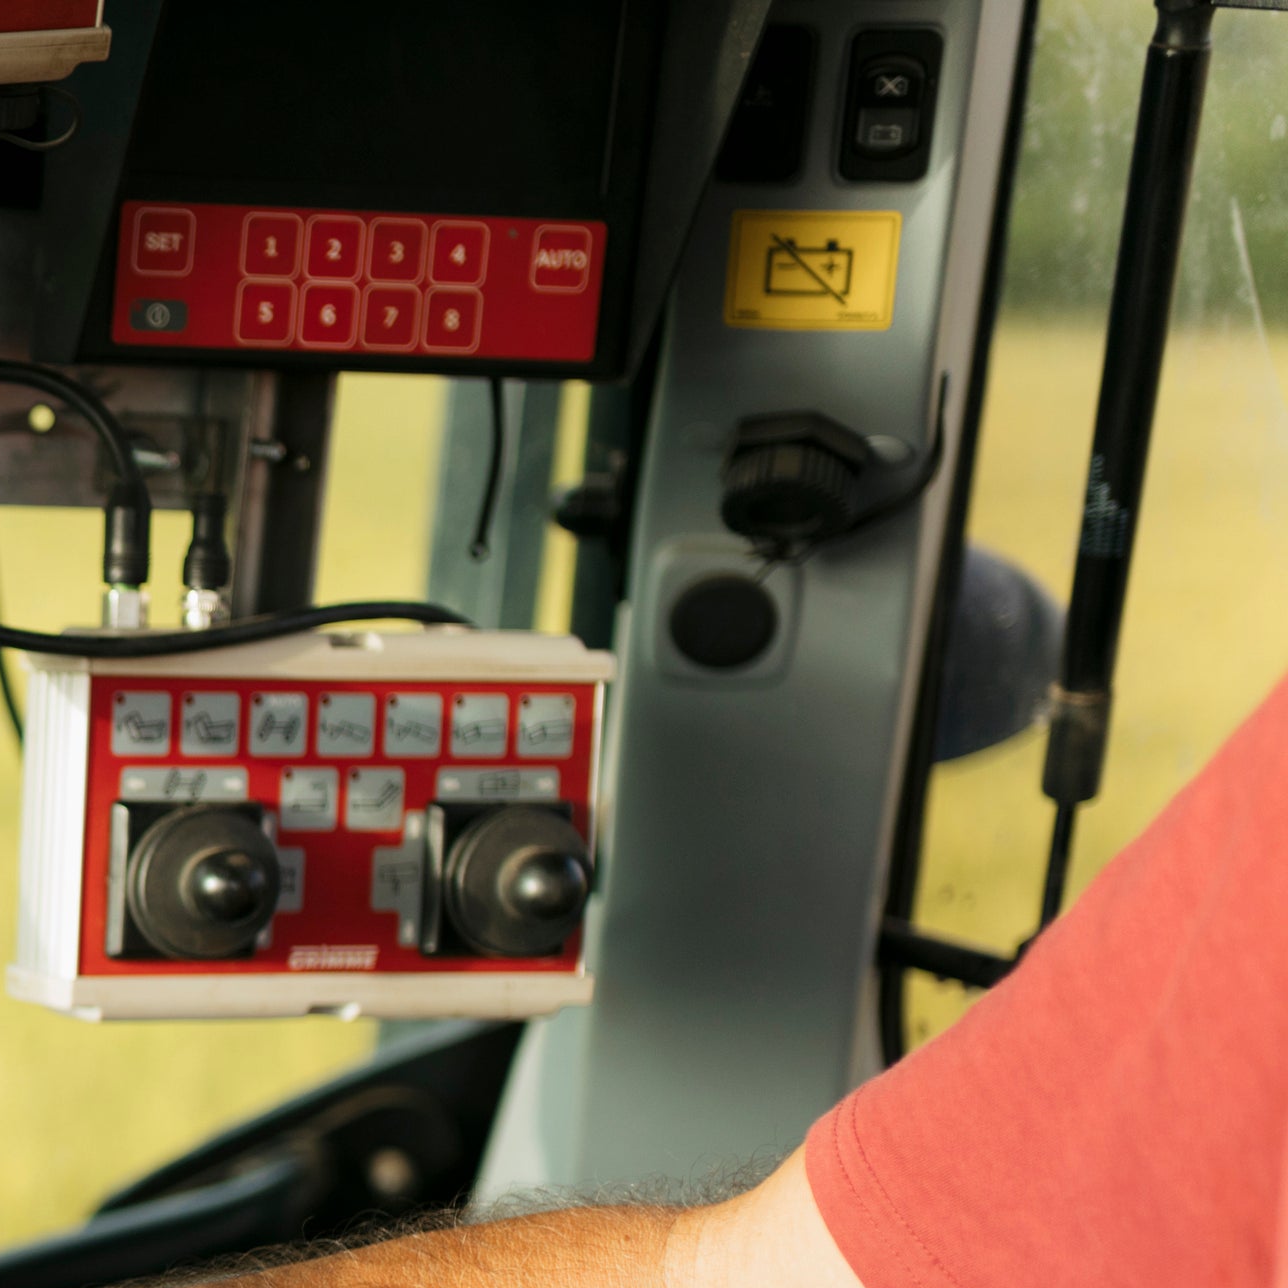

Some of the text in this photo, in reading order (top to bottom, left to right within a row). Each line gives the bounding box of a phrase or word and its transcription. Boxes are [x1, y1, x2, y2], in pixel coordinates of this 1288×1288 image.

[145, 232, 183, 253] SET
[264, 236, 279, 258] 1
[326, 239, 342, 261] 2
[389, 240, 404, 264] 3
[451, 243, 466, 266] 4
[537, 249, 588, 270] AUTO
[258, 302, 273, 324] 5
[320, 304, 336, 326] 6
[384, 306, 399, 328] 7
[444, 308, 460, 330] 8
